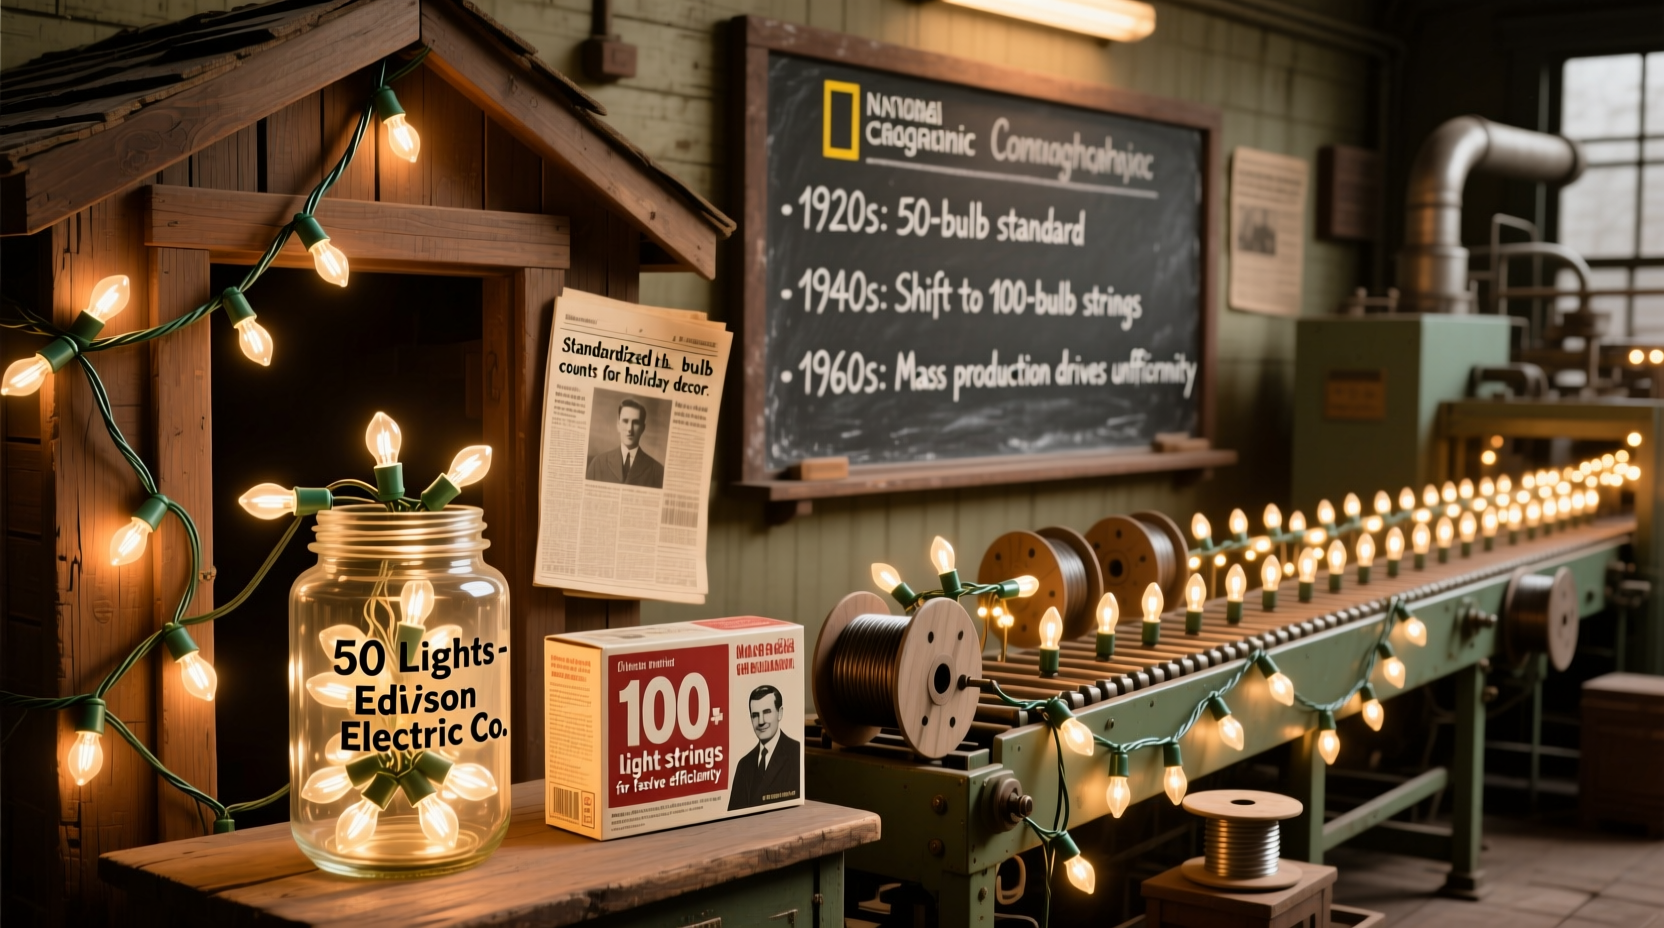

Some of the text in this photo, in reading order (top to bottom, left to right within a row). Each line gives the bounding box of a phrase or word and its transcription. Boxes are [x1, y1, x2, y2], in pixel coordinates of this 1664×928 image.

[798, 185, 1086, 247] 1920s: 50-bulb standard
[798, 267, 1144, 332] 1940s: Shift to 100-bulb strings
[558, 361, 710, 397] counts for holiday decor.
[681, 356, 714, 377] bulb
[798, 348, 887, 398] 1960s:
[894, 349, 948, 392] Mass
[953, 347, 1052, 403] production
[1054, 347, 1108, 386] drives
[333, 639, 386, 677] 50
[399, 637, 508, 680] Lights-
[340, 711, 508, 752] Electric Co.
[664, 743, 724, 769] strings
